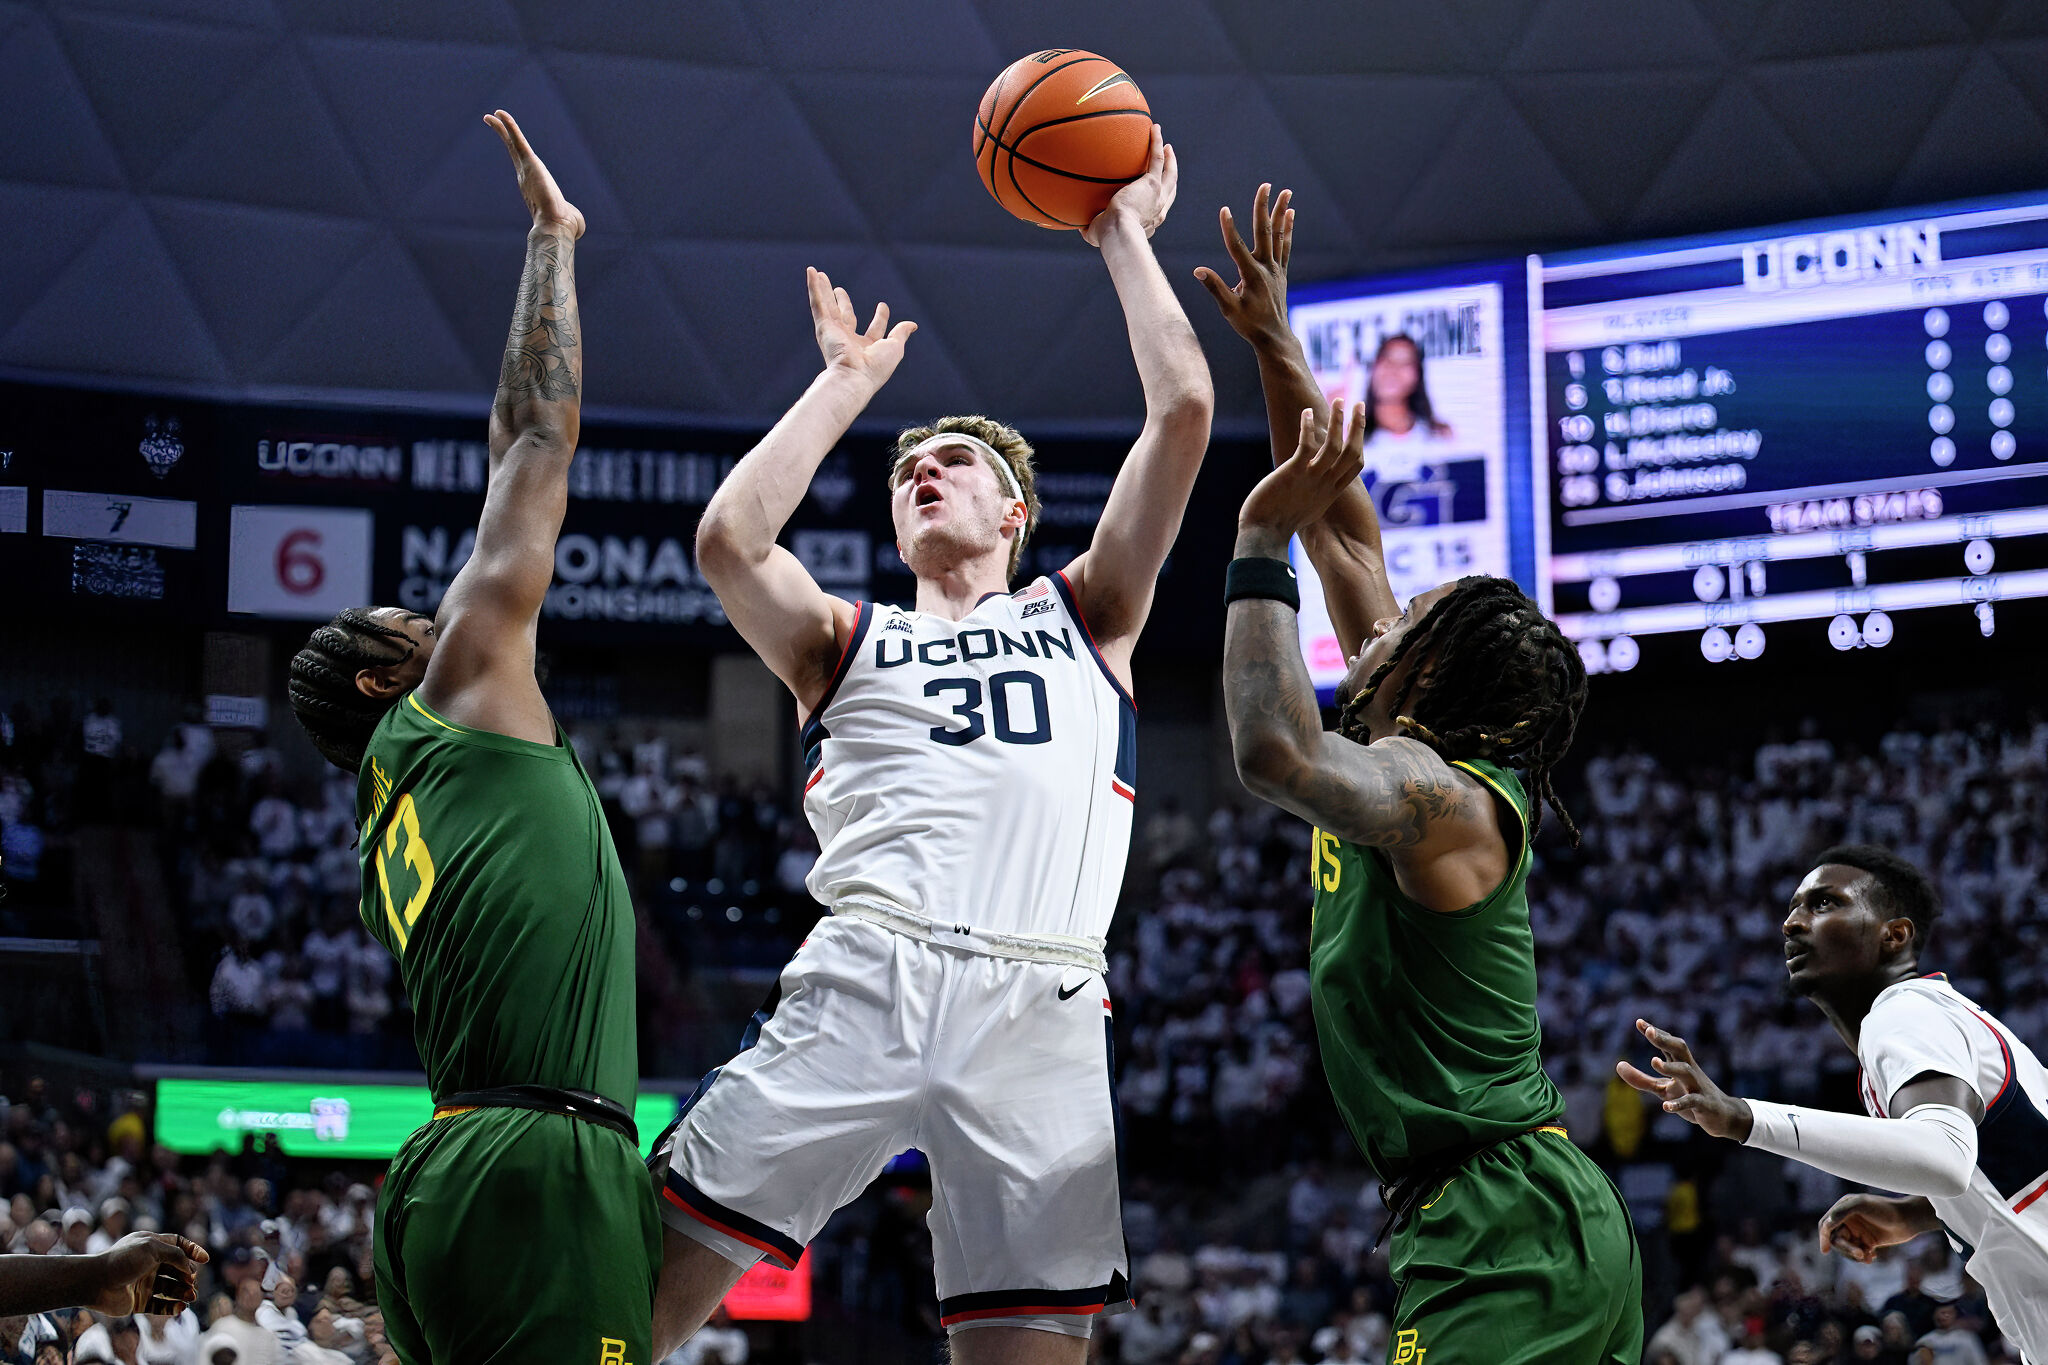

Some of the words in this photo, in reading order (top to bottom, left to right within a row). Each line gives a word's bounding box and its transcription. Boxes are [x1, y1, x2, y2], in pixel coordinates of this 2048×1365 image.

[1743, 222, 1940, 292] UCONN
[258, 439, 400, 480] UCONN
[274, 528, 325, 596] 6
[1022, 602, 1057, 617] EAST
[1024, 599, 1049, 611] BIG
[876, 627, 1077, 669] UCONN
[923, 670, 1052, 747] 30
[375, 792, 435, 955] 13
